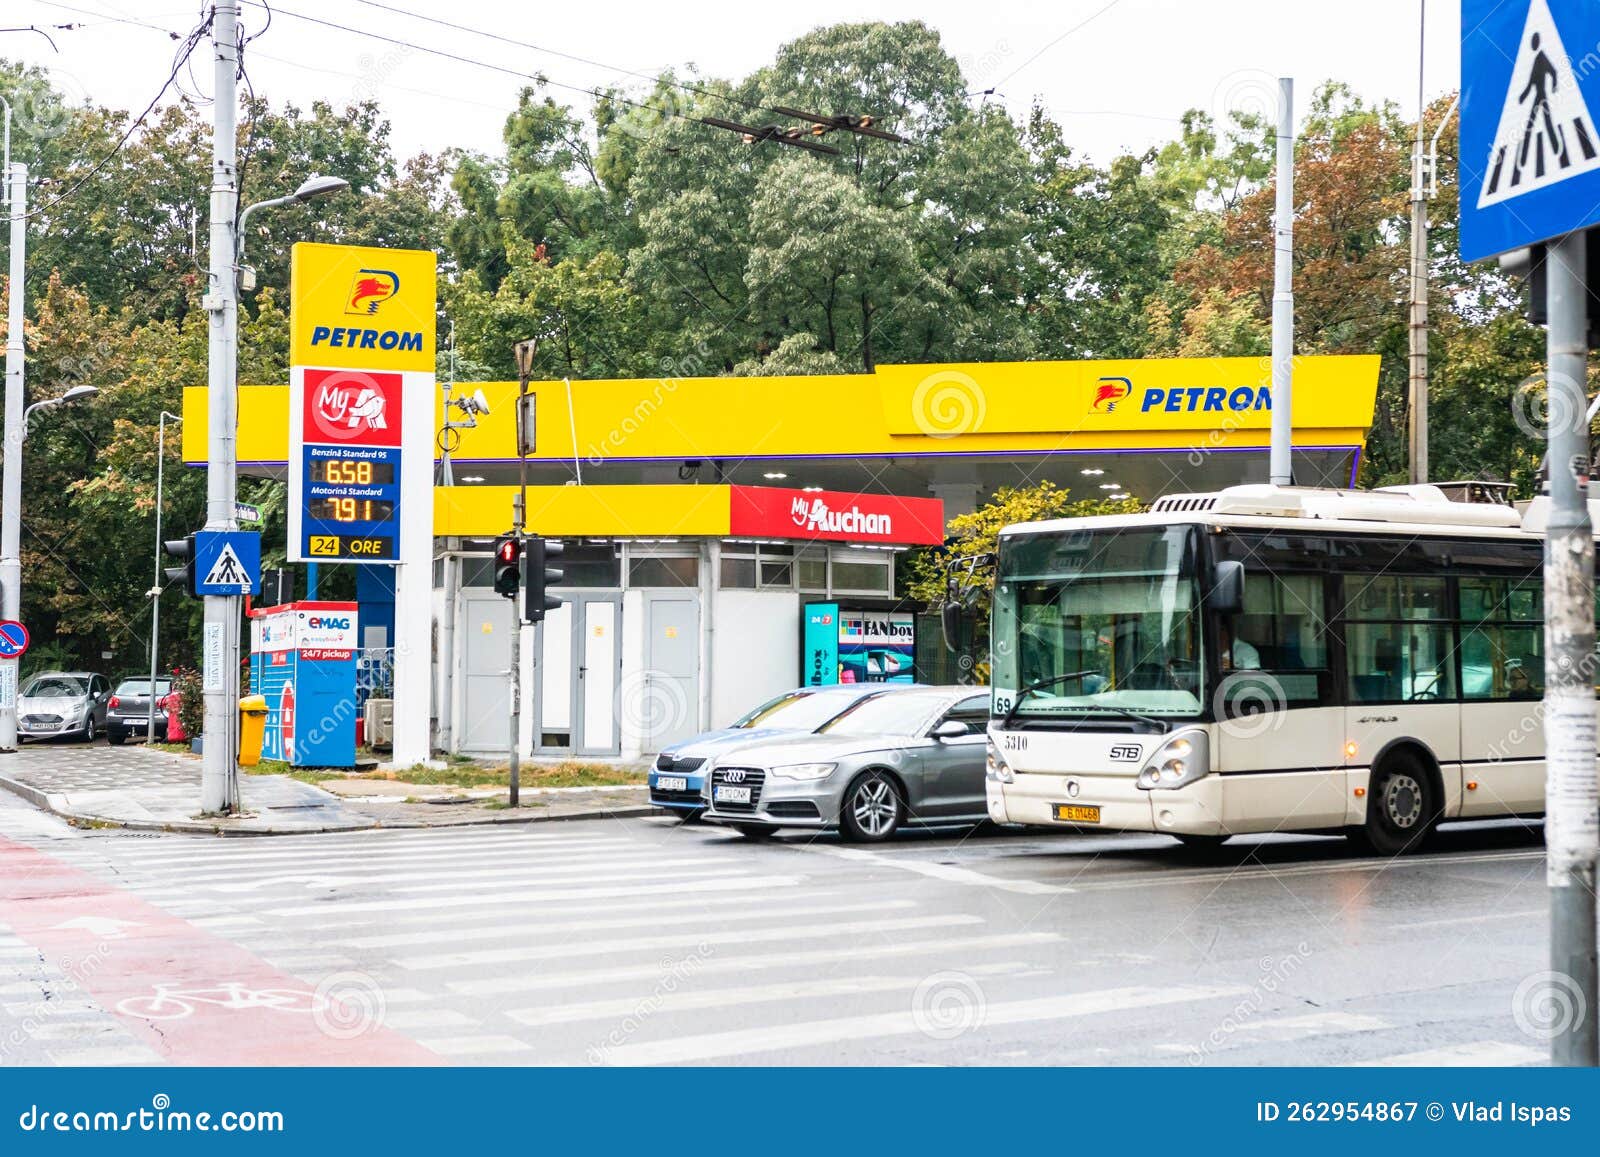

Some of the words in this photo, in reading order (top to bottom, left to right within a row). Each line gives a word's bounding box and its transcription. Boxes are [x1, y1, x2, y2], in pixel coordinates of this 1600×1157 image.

[311, 326, 423, 351] PETROM
[318, 385, 350, 421] My
[311, 448, 342, 457] Benzină
[342, 449, 377, 458] Standard
[378, 451, 387, 459] 95
[311, 486, 347, 495] Motorină
[348, 488, 383, 496] Standard
[791, 497, 809, 525] My
[807, 499, 891, 535] Auchan
[314, 538, 336, 553] 24
[350, 540, 382, 554] ORE
[308, 617, 350, 630] eMAG
[302, 649, 321, 658] 24/7
[322, 649, 350, 660] pickup
[996, 697, 1011, 713] 69
[1005, 735, 1028, 750] 5310
[1110, 746, 1140, 759] STB
